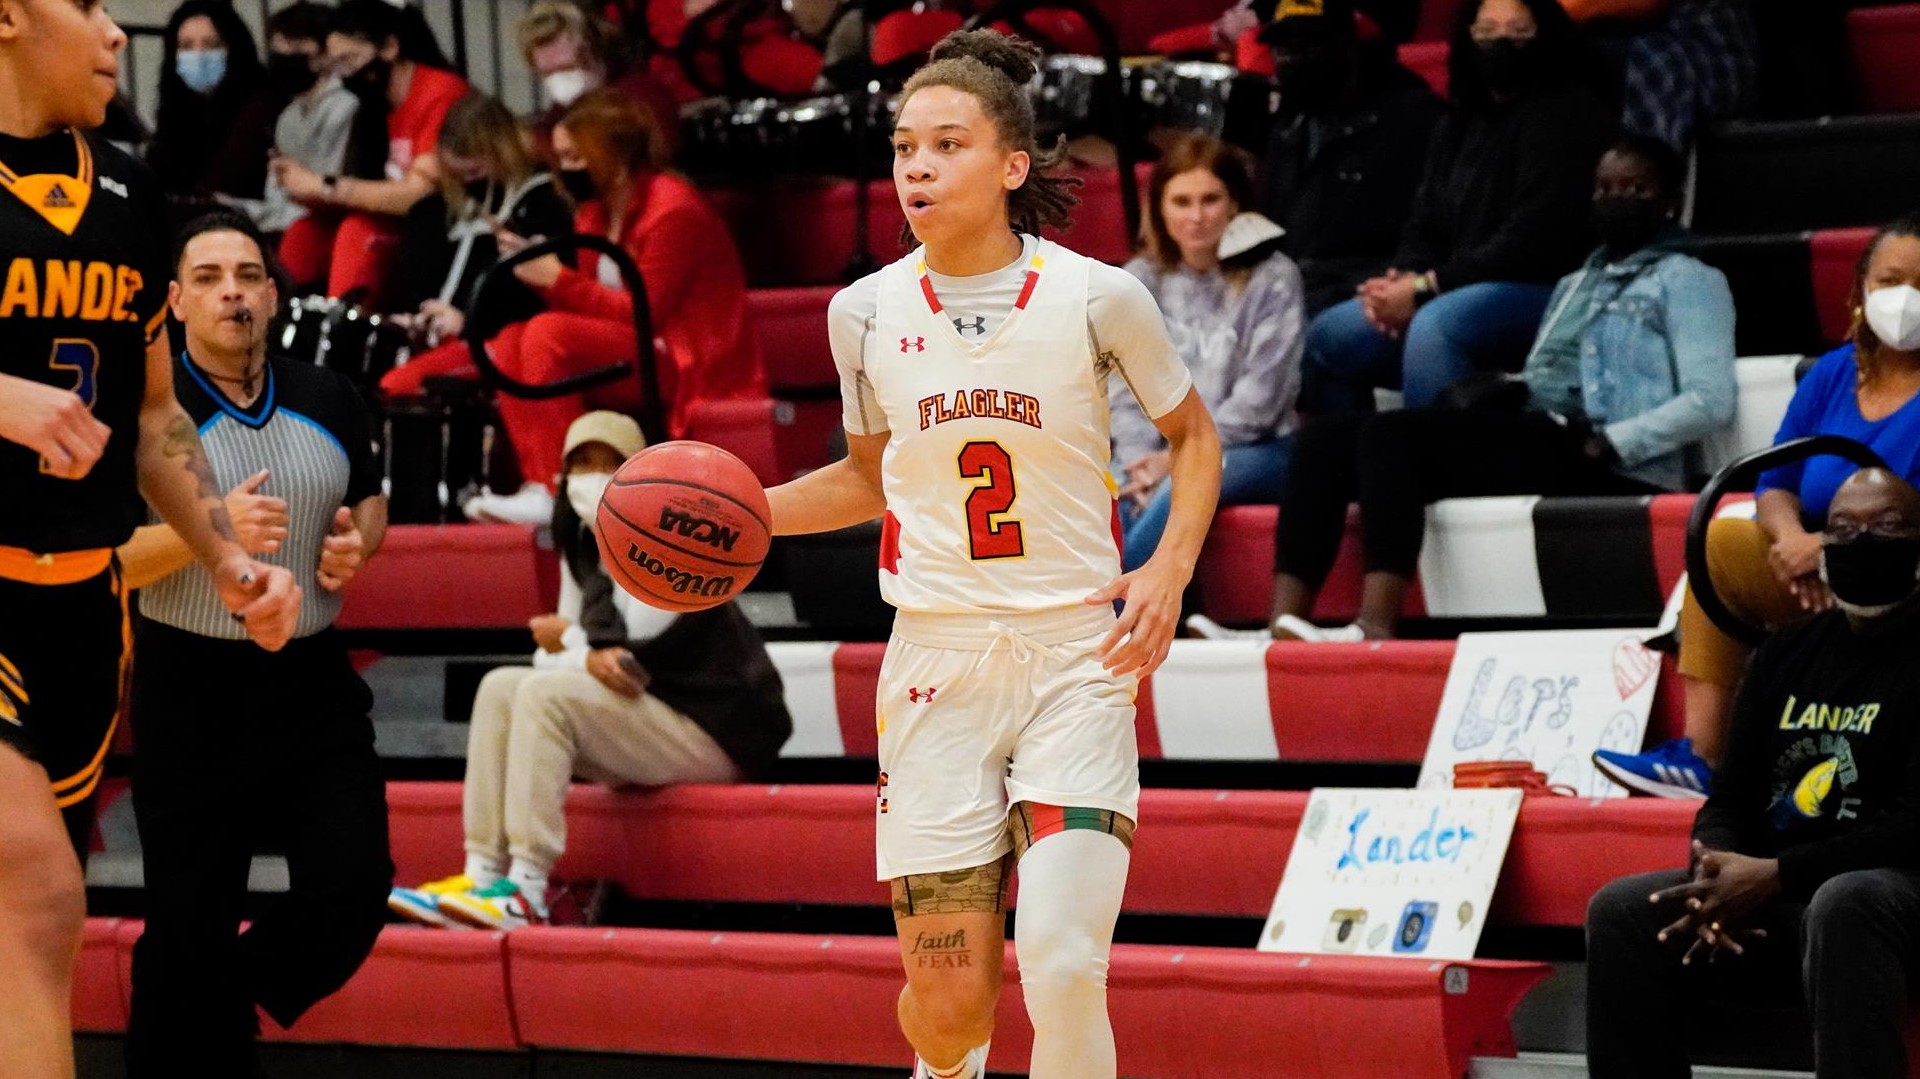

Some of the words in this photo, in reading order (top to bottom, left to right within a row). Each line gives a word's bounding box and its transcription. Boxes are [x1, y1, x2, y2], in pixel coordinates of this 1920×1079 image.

[0, 257, 144, 322] ANDE
[918, 388, 1042, 431] FLAGLER
[956, 438, 1026, 561] 2
[660, 505, 741, 553] NCAA
[627, 542, 736, 597] Wilson
[1779, 693, 1881, 735] LANDER
[1337, 805, 1476, 870] Lander
[911, 928, 966, 955] faith
[917, 955, 972, 969] FEAR
